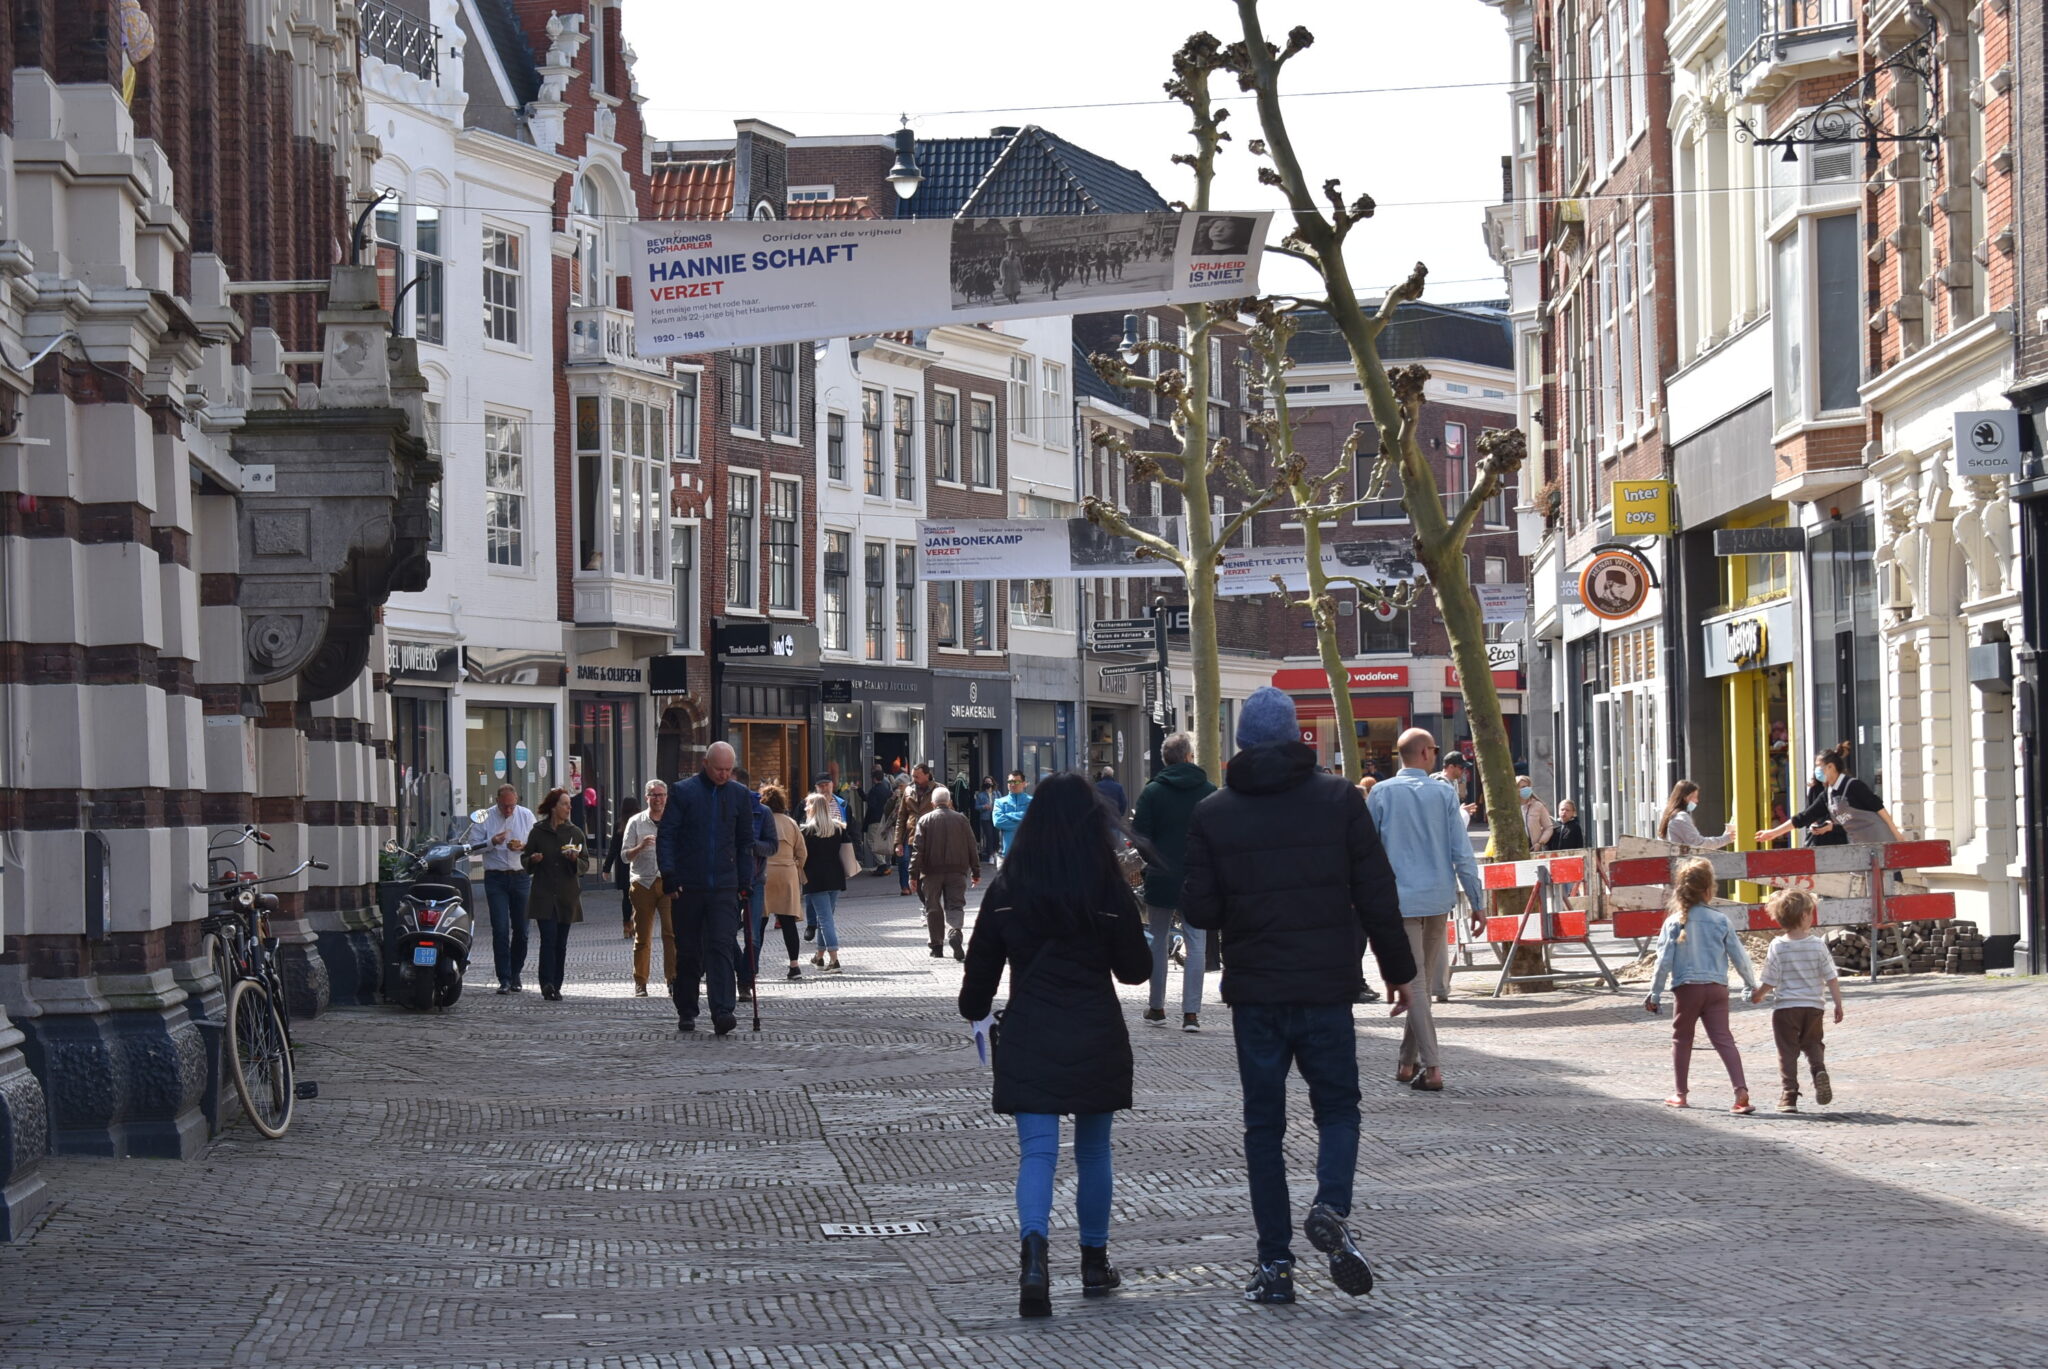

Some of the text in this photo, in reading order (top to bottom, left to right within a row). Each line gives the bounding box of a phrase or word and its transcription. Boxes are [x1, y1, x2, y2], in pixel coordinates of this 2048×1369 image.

[762, 228, 902, 242] Corridor van de vrijheid
[647, 241, 713, 255] POPHAARLEM
[649, 243, 859, 283] HANNIE SCHAFT
[1190, 261, 1246, 271] VRIJHEID
[1189, 268, 1245, 283] IS NIET
[650, 281, 725, 302] VERZET
[651, 307, 665, 316] Het
[666, 305, 692, 315] meisje
[692, 303, 708, 312] met
[708, 301, 722, 310] het
[722, 299, 741, 308] rode
[651, 316, 675, 325] Kwam
[676, 314, 688, 322] als
[724, 309, 735, 318] bij
[735, 308, 749, 316] het
[749, 303, 790, 314] Haarlemse
[653, 333, 675, 343] 1920
[683, 330, 705, 340] 1945
[1623, 488, 1659, 502] Inter
[1626, 511, 1656, 525] toys
[925, 535, 1023, 547] JAN BONEKAMP
[925, 548, 961, 556] VERZET
[1591, 559, 1639, 577] HENRI WILLIG
[729, 645, 759, 653] Timberland
[1488, 646, 1516, 661] Etos
[401, 645, 438, 673] JUWELIERS
[577, 665, 641, 683] BANG & OLUFSEN
[1353, 671, 1399, 681] vodafone
[851, 680, 863, 688] NEW
[951, 705, 996, 719] SNEAKERS.NL
